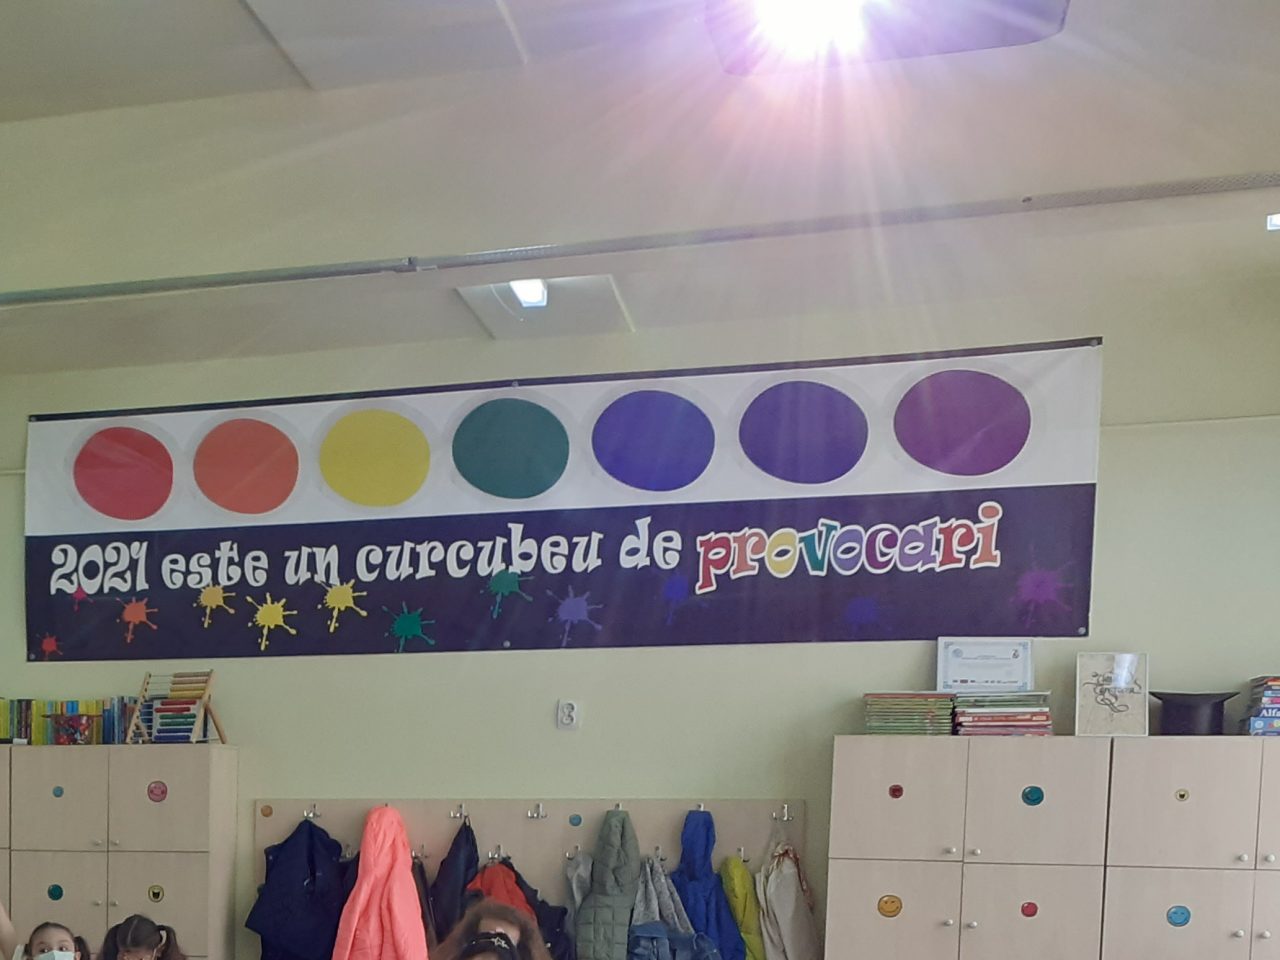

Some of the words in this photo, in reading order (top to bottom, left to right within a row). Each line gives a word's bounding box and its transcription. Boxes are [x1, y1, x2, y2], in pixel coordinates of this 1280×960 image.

[50, 541, 149, 595] 2021
[161, 541, 269, 590] este
[284, 544, 339, 586] un
[356, 523, 604, 583] curcubeu
[619, 516, 682, 570] de
[695, 501, 1003, 595] provocari
